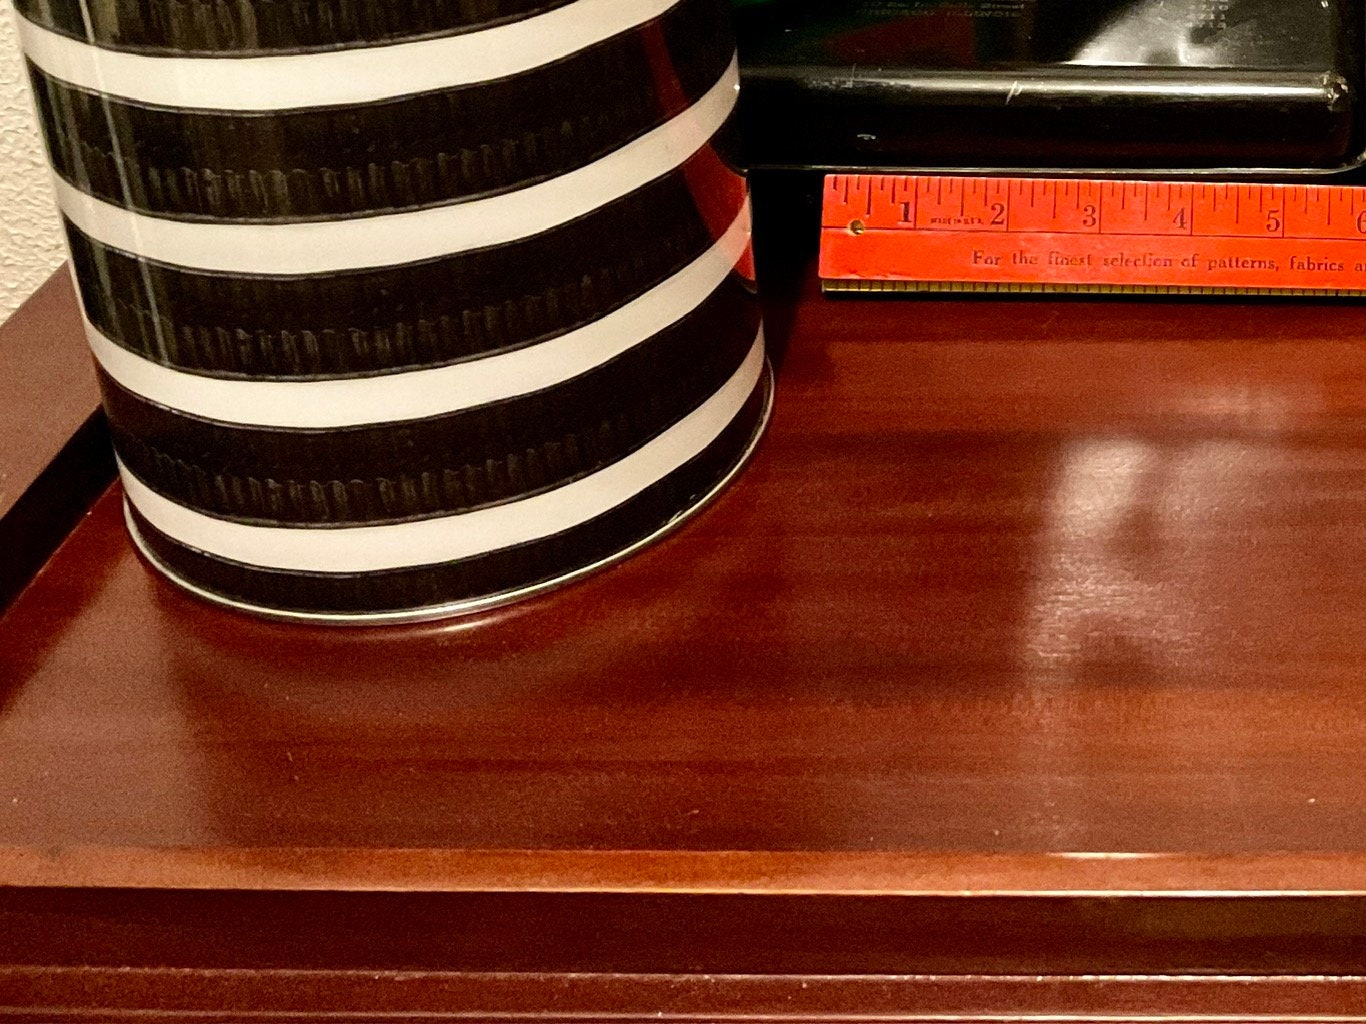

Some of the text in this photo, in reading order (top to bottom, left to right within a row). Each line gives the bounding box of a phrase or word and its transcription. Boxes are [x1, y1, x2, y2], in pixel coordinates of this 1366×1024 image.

[897, 201, 912, 225] 1
[990, 202, 1006, 226] 2
[1082, 204, 1097, 227] 3
[1171, 207, 1188, 229] 4
[1265, 208, 1281, 234] 5
[972, 250, 1000, 267] For
[1012, 250, 1039, 267] the
[1048, 251, 1093, 268] finest
[1103, 251, 1173, 268] selection
[1180, 253, 1199, 268] of
[1207, 256, 1280, 273] patterns,
[1289, 256, 1345, 272] fabrics
